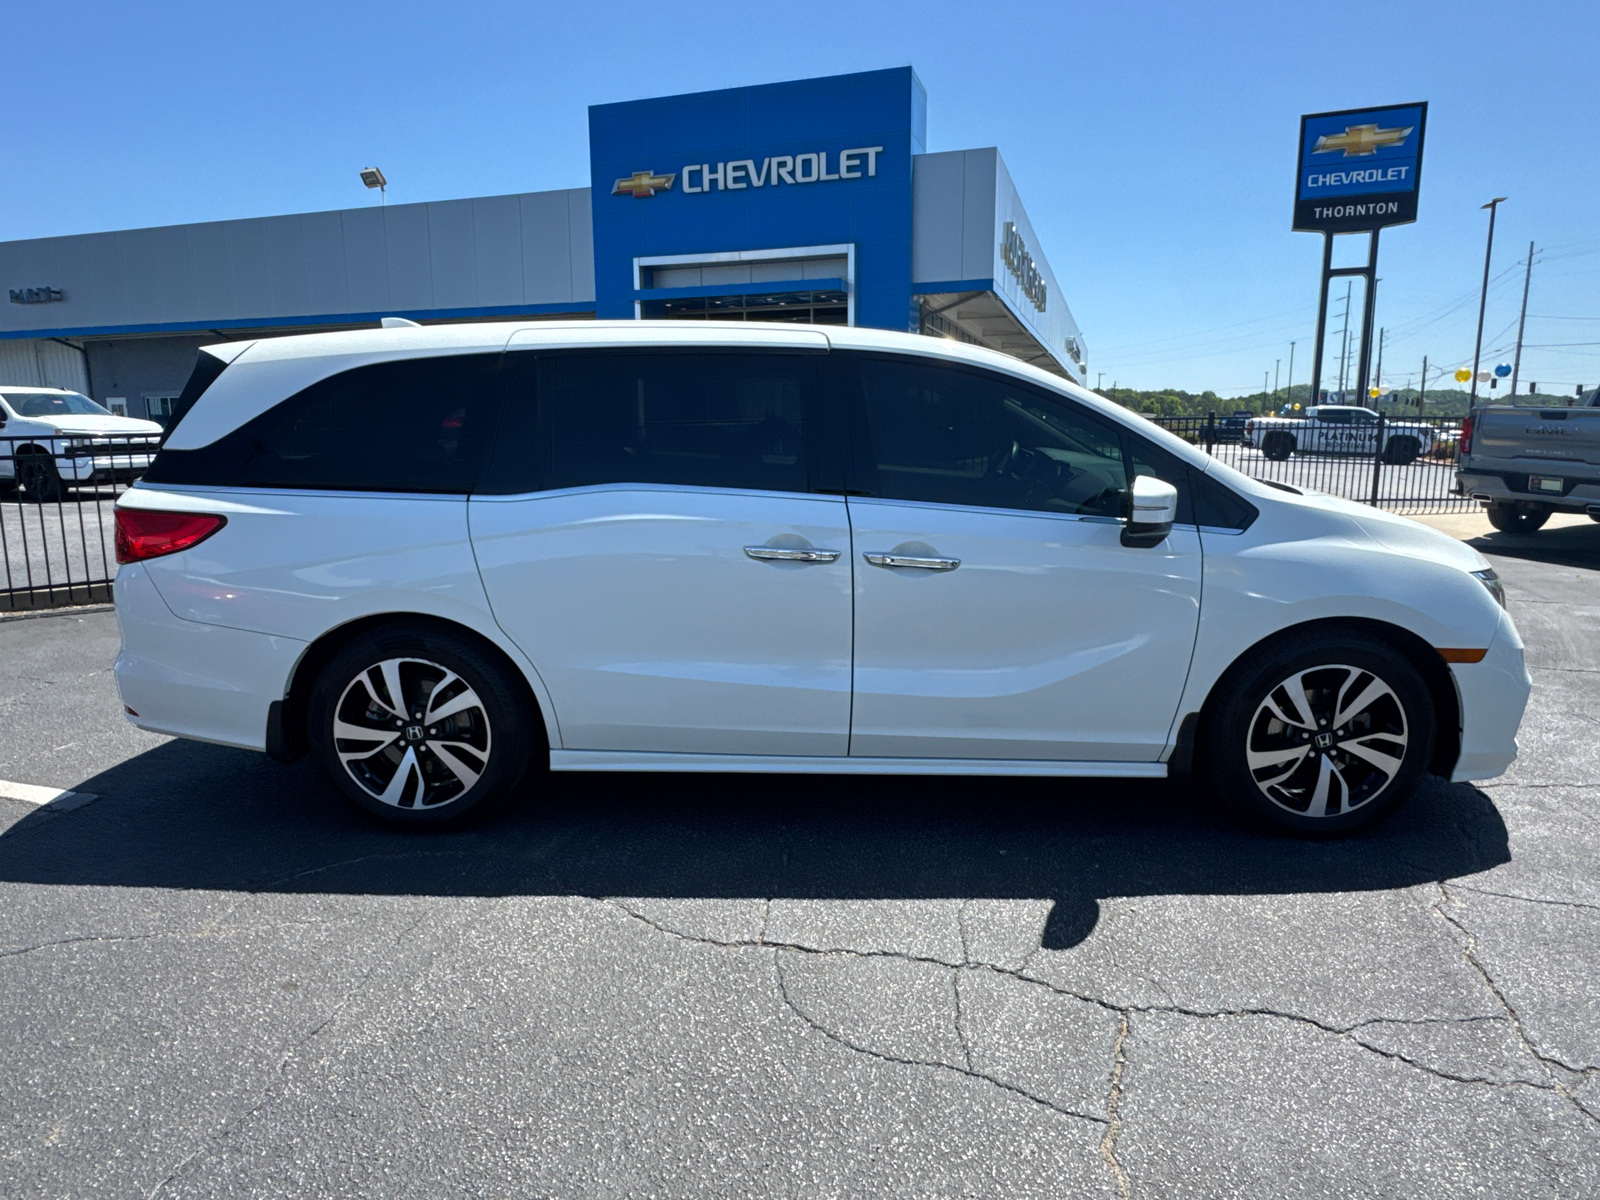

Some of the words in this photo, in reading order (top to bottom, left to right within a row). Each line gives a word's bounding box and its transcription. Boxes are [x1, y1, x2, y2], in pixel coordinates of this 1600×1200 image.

[682, 146, 883, 194] CHEVROLET
[1307, 166, 1409, 187] CHEVROLET
[1314, 202, 1398, 219] THORNTON
[1318, 431, 1379, 442] PLATINUM
[1526, 426, 1578, 436] GMC
